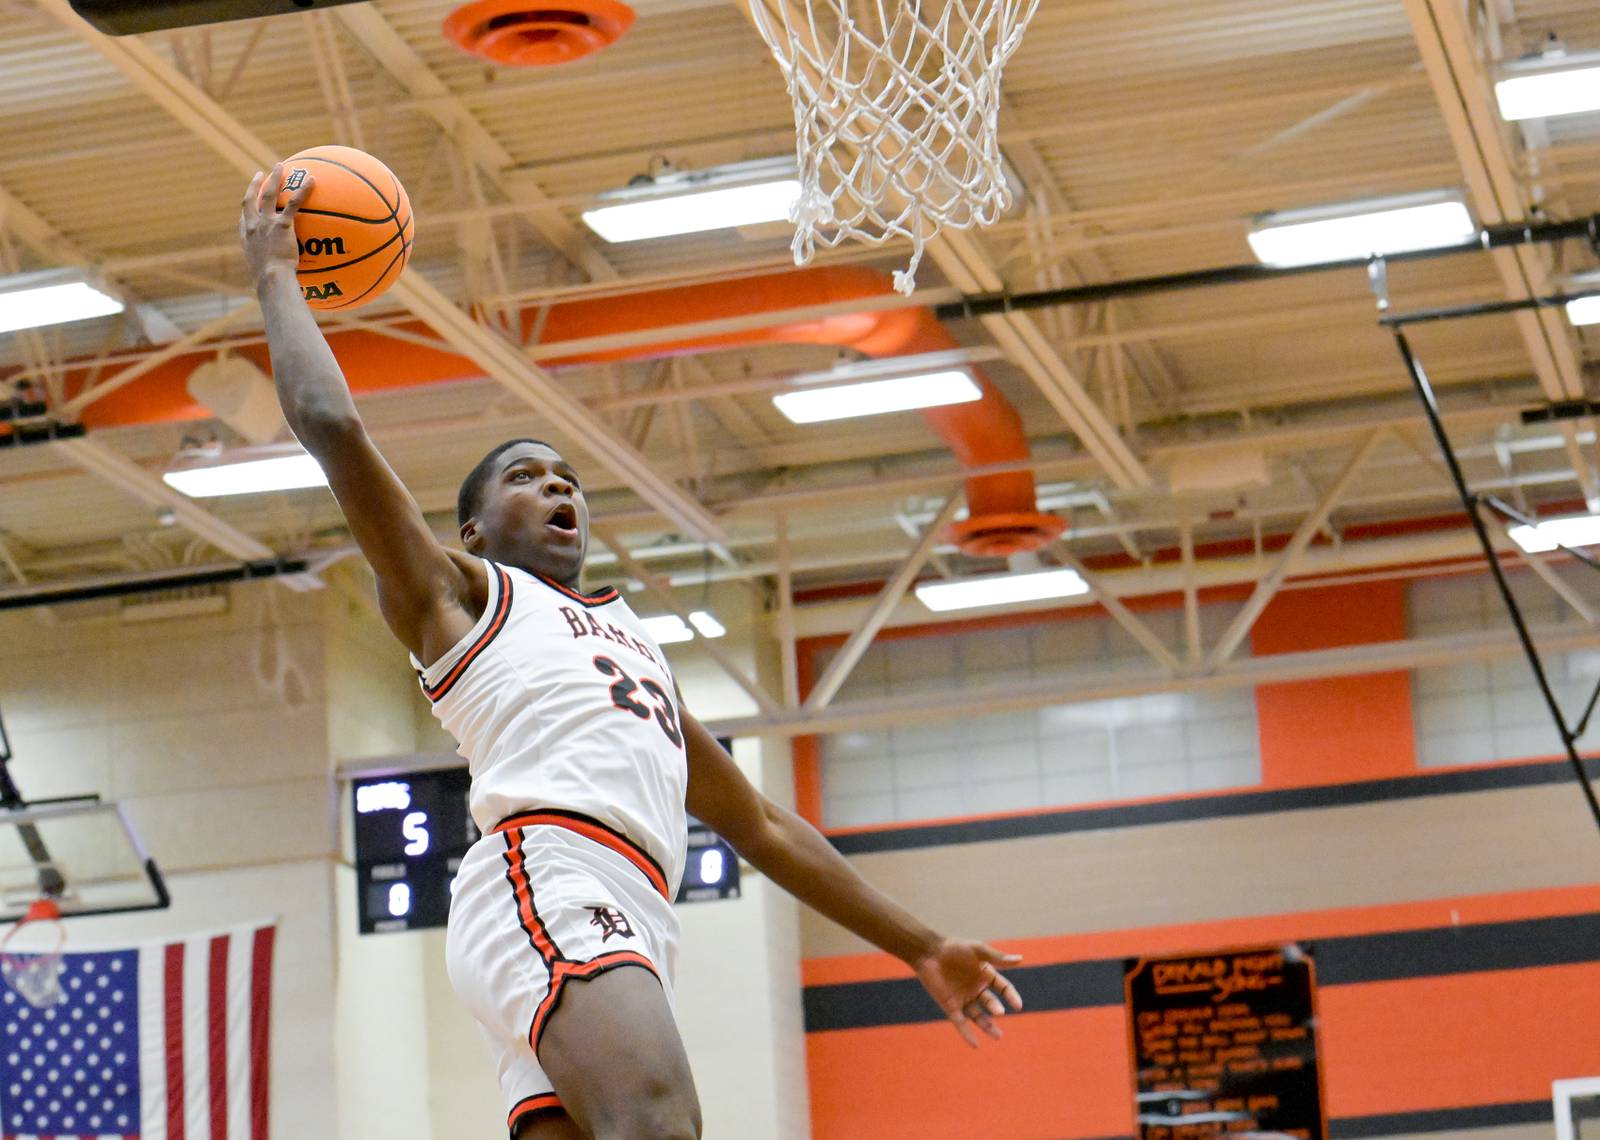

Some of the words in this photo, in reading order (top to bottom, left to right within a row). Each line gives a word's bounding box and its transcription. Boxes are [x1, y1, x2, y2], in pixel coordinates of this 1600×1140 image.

[300, 281, 344, 301] AA
[592, 654, 683, 751] 23
[402, 811, 430, 857] 5
